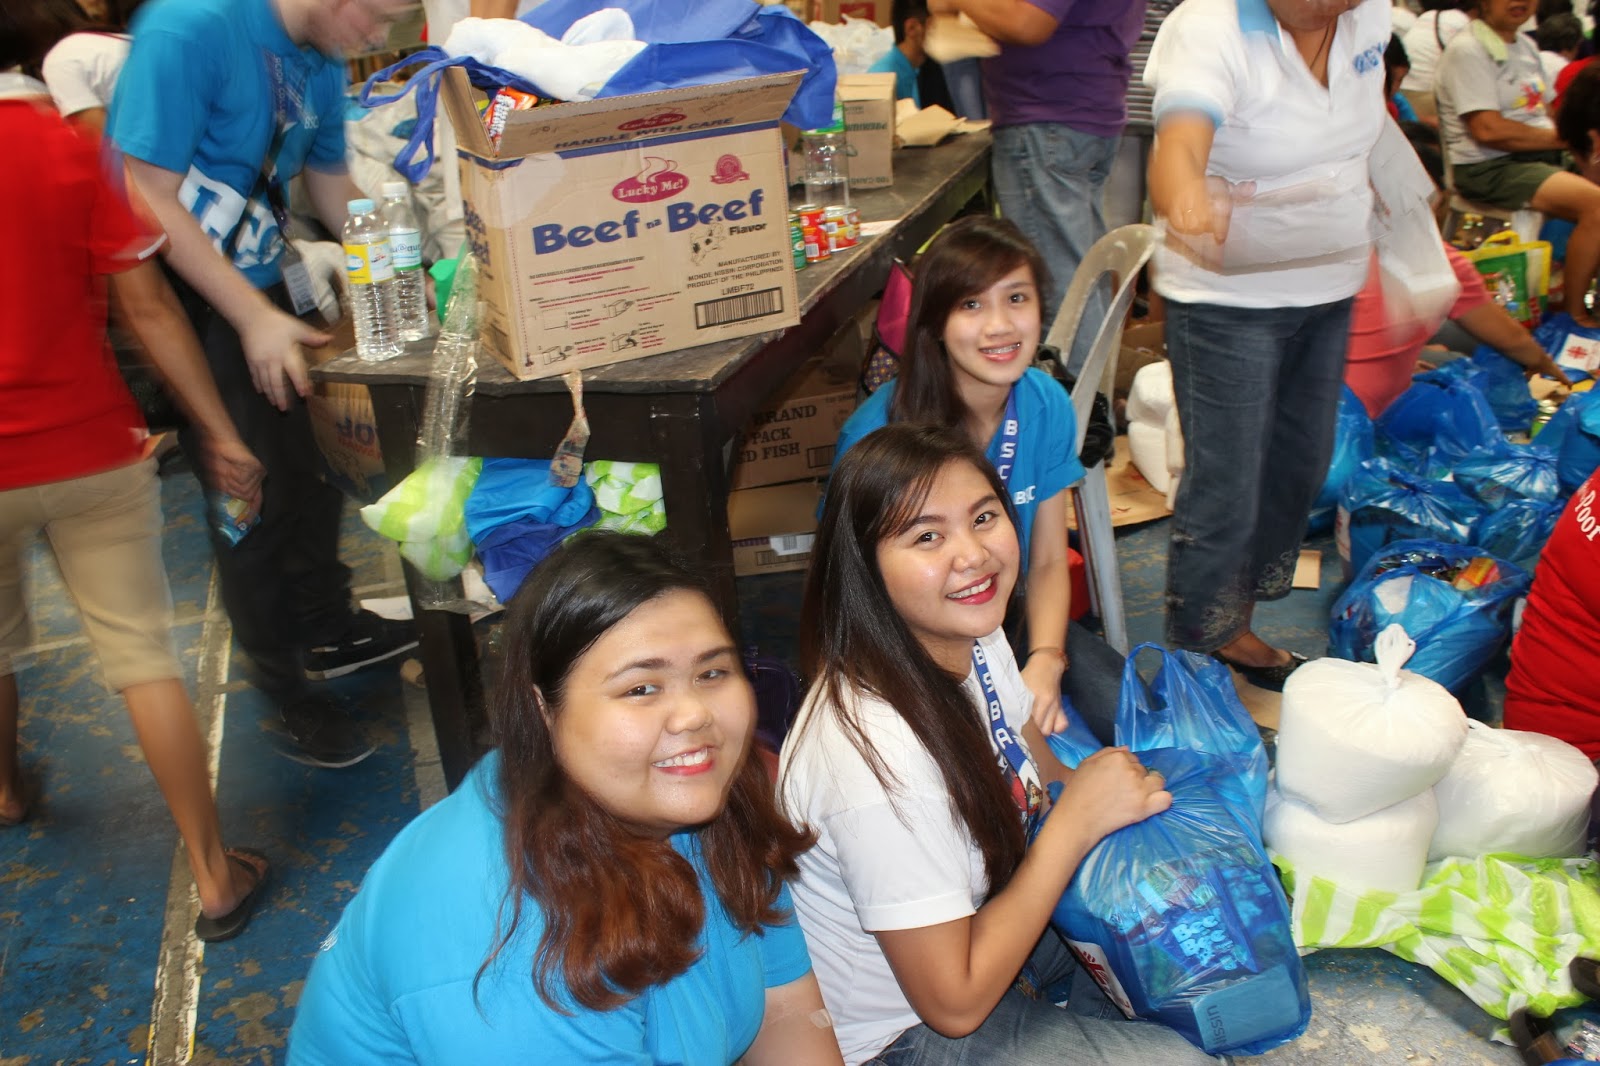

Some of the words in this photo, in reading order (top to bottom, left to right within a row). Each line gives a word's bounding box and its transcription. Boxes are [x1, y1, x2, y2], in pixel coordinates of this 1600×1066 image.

[555, 134, 630, 148] HANDLE
[636, 124, 682, 137] WITH
[687, 117, 734, 130] CARE
[618, 183, 658, 199] Lucky
[661, 178, 684, 193] Me!
[532, 209, 640, 255] Beef
[646, 219, 662, 230] na
[666, 189, 764, 233] Beef
[729, 223, 768, 236] Flavor
[718, 253, 771, 267] MANUFACTURED
[772, 250, 781, 258] BY
[687, 278, 719, 289] PRODUCT
[731, 273, 744, 281] THE
[745, 265, 784, 277] PHILIPPINES
[688, 271, 712, 281] MONDE
[714, 267, 735, 276] NISSIN
[737, 258, 783, 271] CORPORATION
[722, 283, 755, 296] LMBF72
[752, 427, 792, 445] PACK
[762, 442, 801, 460] FISH
[1013, 485, 1036, 505] BC
